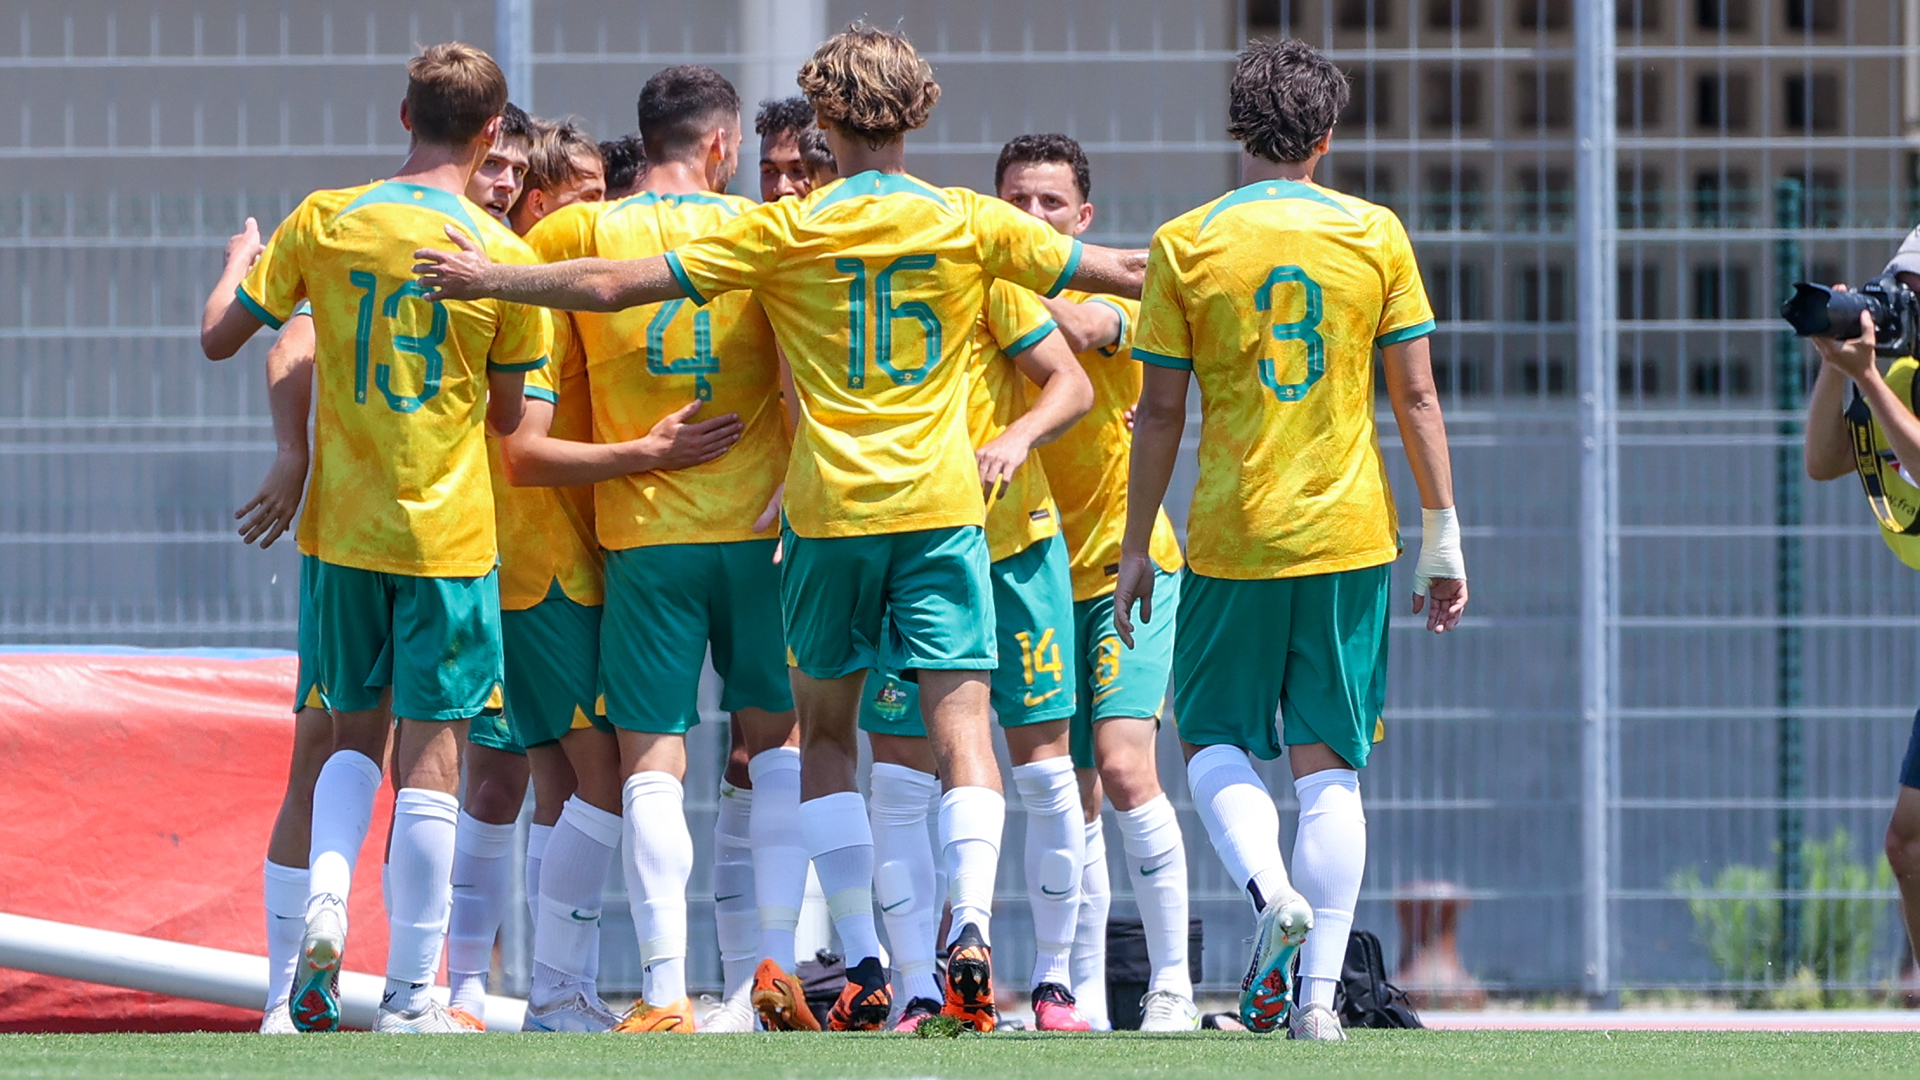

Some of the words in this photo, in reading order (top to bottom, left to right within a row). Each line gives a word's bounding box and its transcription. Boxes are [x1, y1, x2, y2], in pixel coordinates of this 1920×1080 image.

[349, 269, 448, 414] 13
[646, 298, 720, 402] 4
[835, 253, 942, 389] 16
[1254, 264, 1325, 402] 3
[1015, 628, 1063, 685] 14
[1096, 636, 1121, 686] 8
